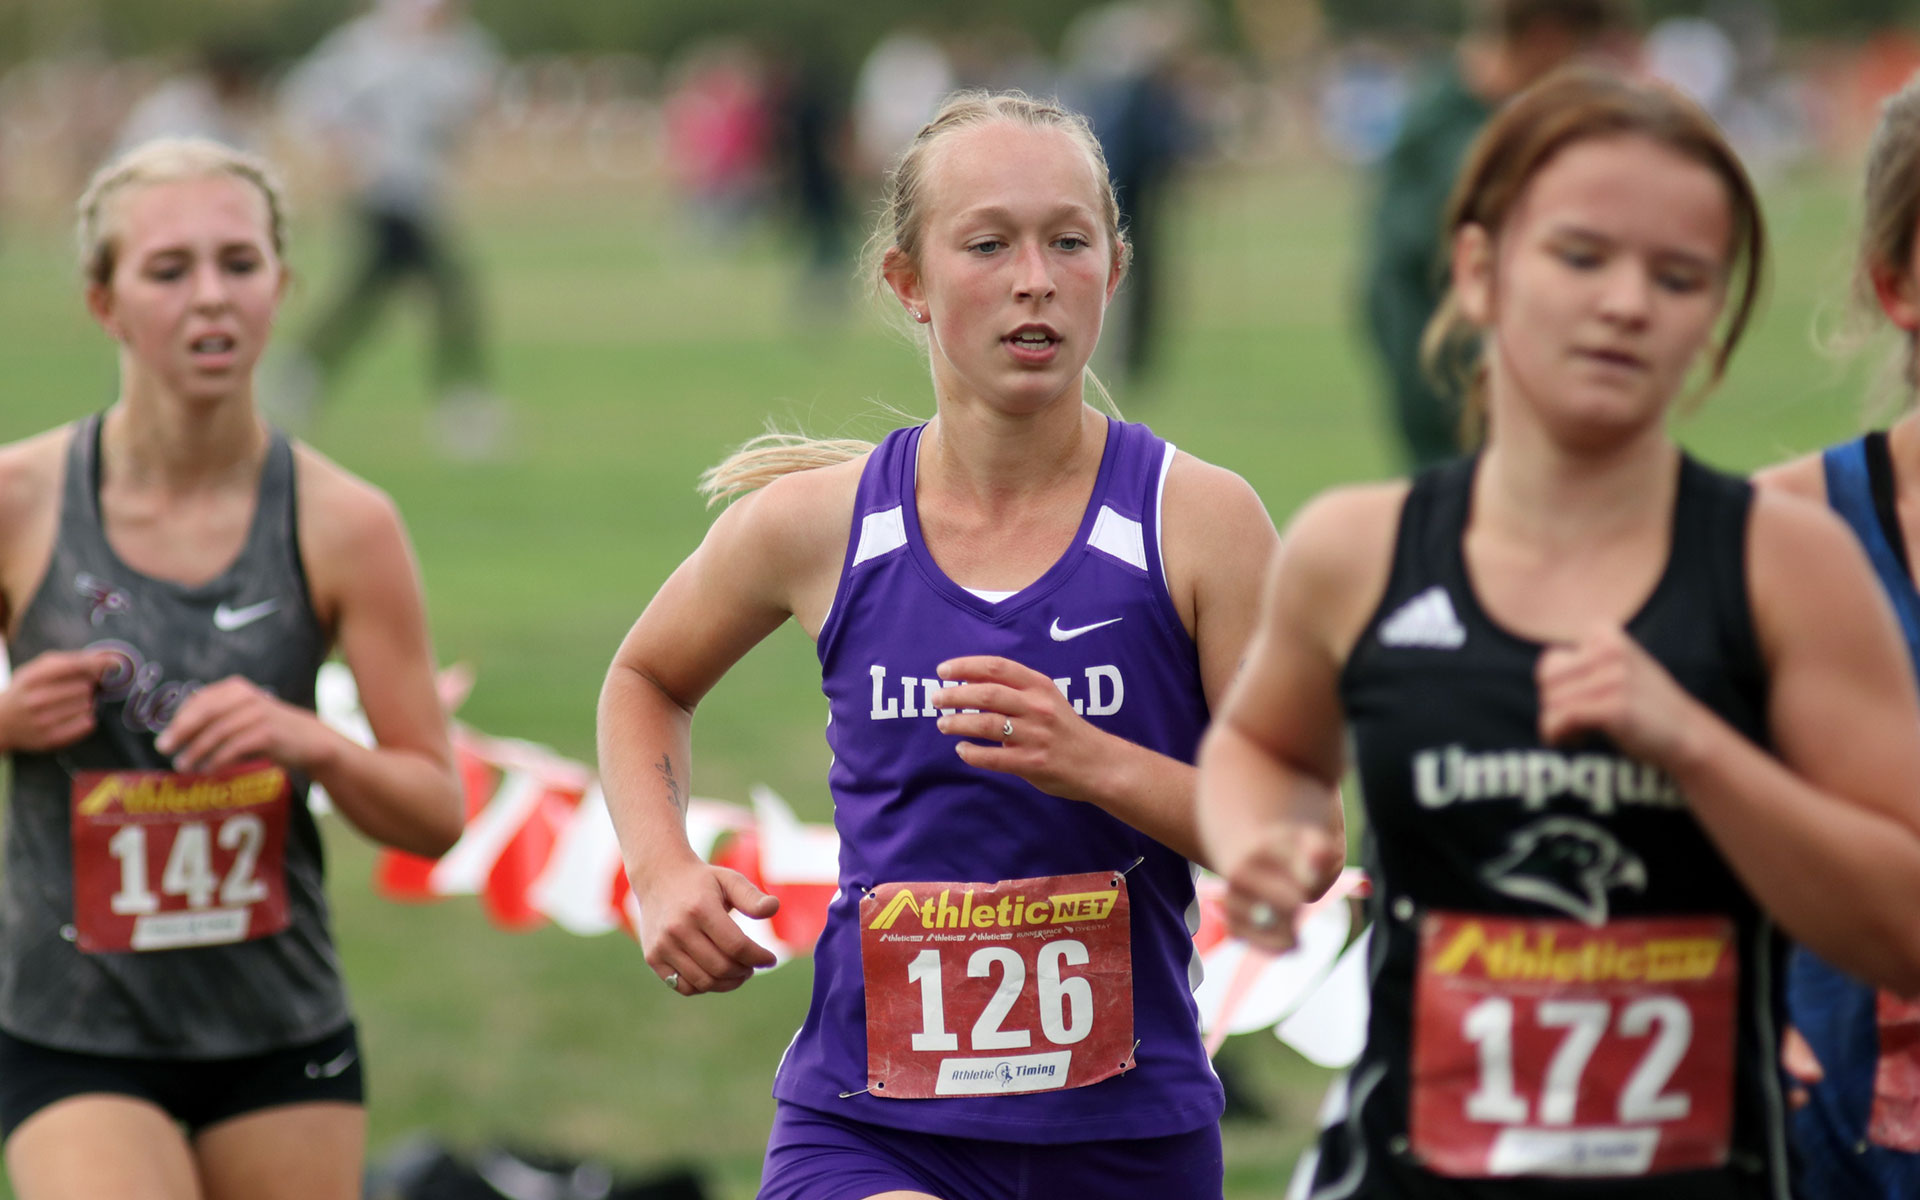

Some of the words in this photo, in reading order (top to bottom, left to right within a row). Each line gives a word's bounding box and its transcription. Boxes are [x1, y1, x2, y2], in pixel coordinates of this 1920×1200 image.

[870, 665, 1124, 720] LINLD
[109, 813, 267, 915] 142
[908, 940, 1093, 1051] 126
[952, 1070, 994, 1080] Athletic
[1016, 1064, 1055, 1076] Timing
[1463, 995, 1693, 1124] 172
